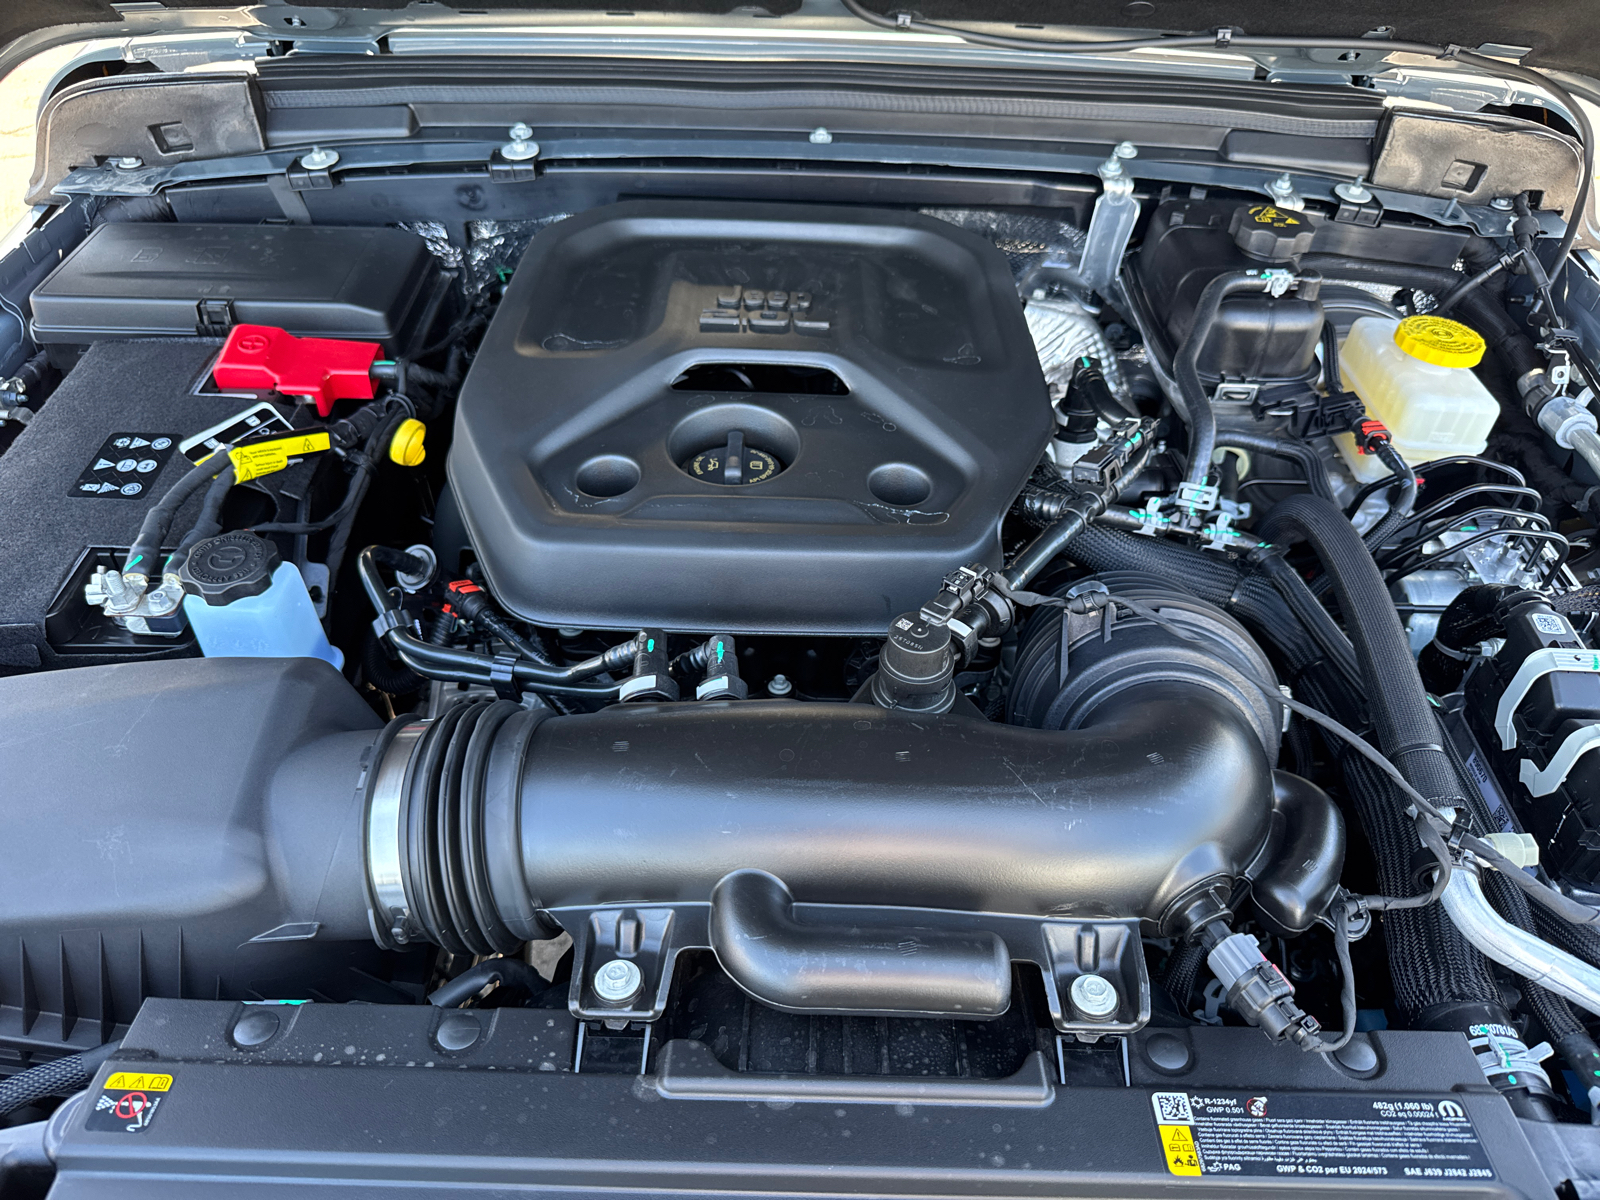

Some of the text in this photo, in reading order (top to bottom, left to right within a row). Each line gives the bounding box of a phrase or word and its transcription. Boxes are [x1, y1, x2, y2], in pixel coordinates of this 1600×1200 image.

[717, 285, 812, 311] Jeep
[194, 543, 212, 558] FLUID
[192, 567, 250, 582] USE APPROVED
[1469, 1024, 1518, 1038] 680781AD
[1204, 1097, 1237, 1106] R-1234yf
[1421, 1102, 1434, 1112] lb)
[1276, 1165, 1296, 1173] GWP
[1298, 1165, 1305, 1173] &
[1306, 1165, 1323, 1173] CO2
[1325, 1167, 1338, 1175] per
[1339, 1166, 1351, 1174] EU
[1404, 1167, 1421, 1176] SAE
